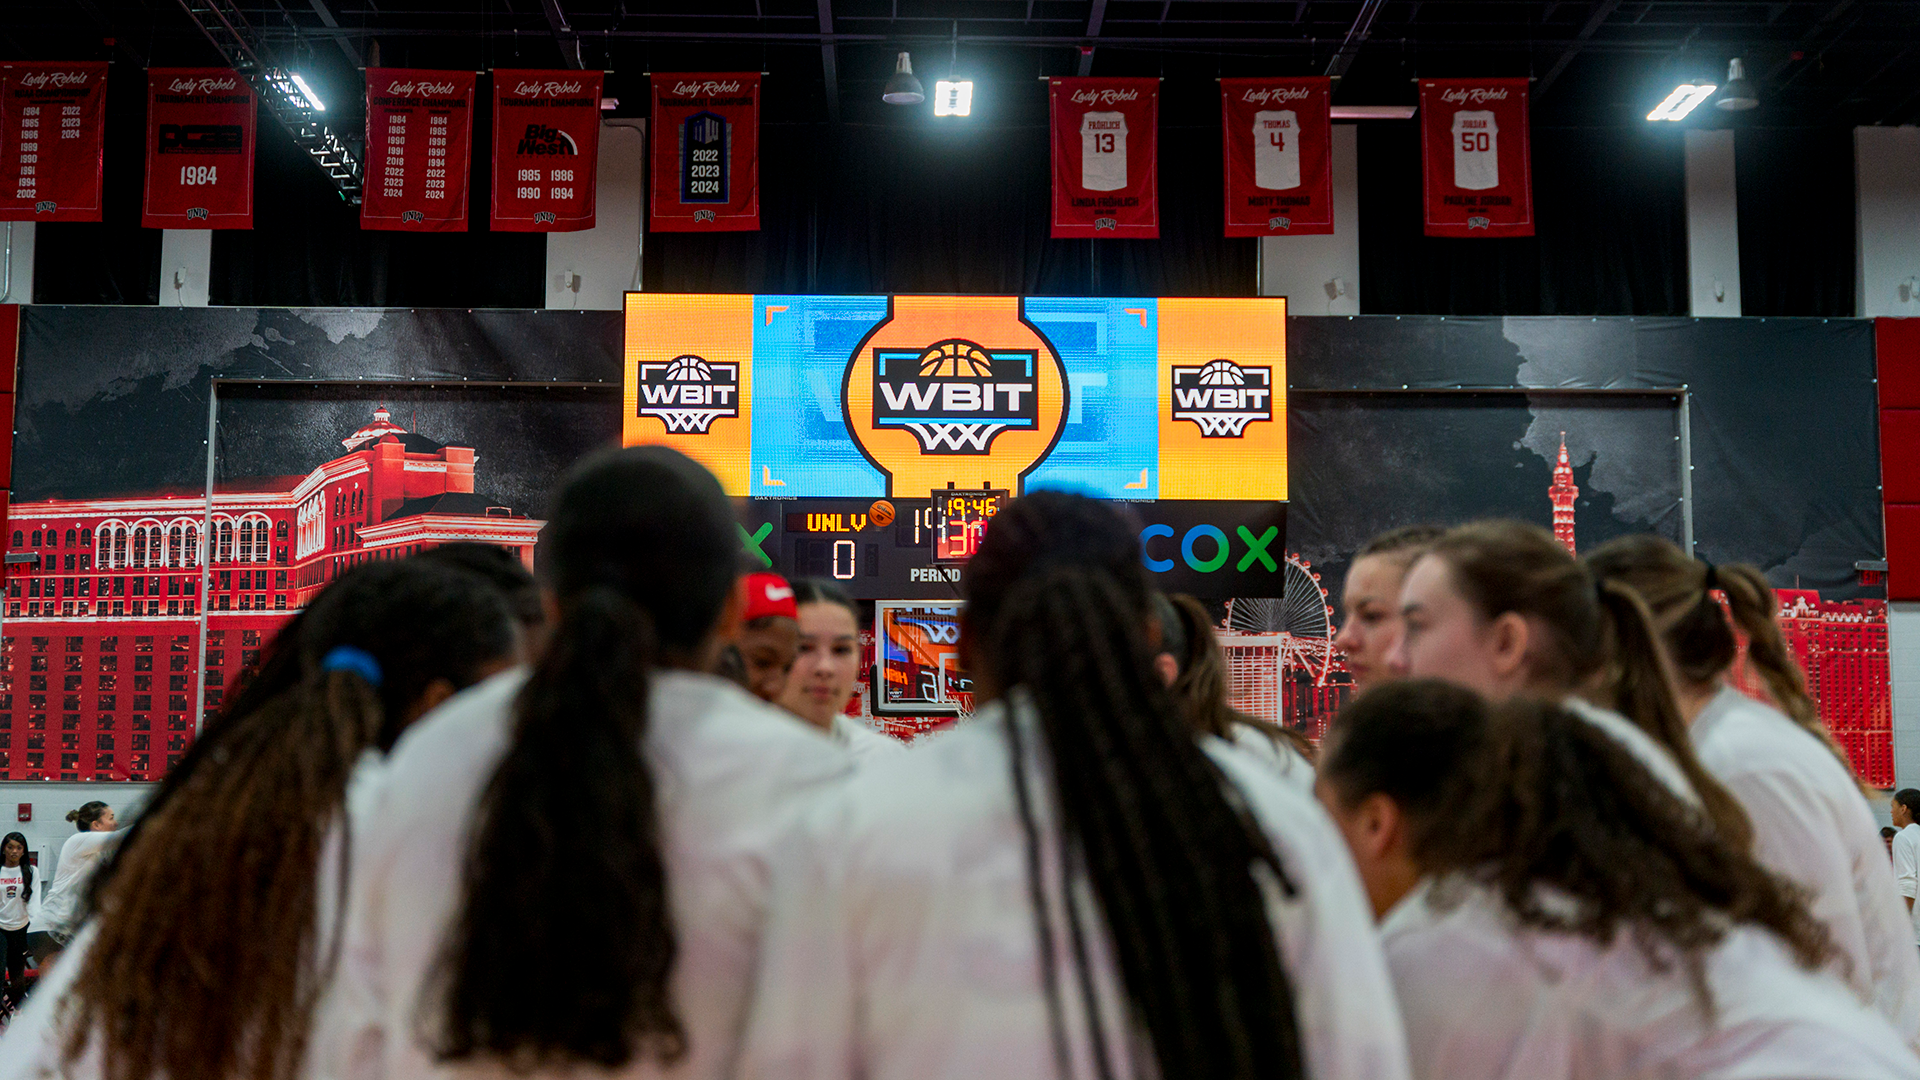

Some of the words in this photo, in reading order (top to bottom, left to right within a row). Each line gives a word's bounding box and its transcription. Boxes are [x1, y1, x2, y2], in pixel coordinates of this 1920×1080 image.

[21, 71, 49, 89] Lady
[50, 72, 87, 87] Rebels
[169, 78, 197, 95] Lady
[199, 78, 236, 94] Rebels
[386, 81, 416, 97] Lady
[417, 82, 455, 97] Rebels
[514, 81, 542, 98] Lady
[544, 81, 581, 96] Rebels
[672, 81, 701, 98] Lady
[702, 81, 740, 96] Rebels
[1071, 89, 1099, 106] Lady
[1101, 89, 1138, 104] Rebels
[1242, 88, 1270, 105] Lady
[1272, 87, 1309, 103] Rebels
[1441, 88, 1470, 105] Lady
[1470, 88, 1508, 104] Rebels
[373, 97, 420, 107] CONFERENCE
[422, 99, 466, 108] CHAMPIONS
[500, 98, 549, 107] TOURNAMENT
[551, 98, 594, 107] CHAMPIONS
[23, 107, 40, 116] 1984
[62, 107, 80, 115] 2022
[22, 119, 39, 127] 1985
[61, 118, 80, 127] 2023
[389, 115, 406, 124] 1984
[430, 116, 447, 125] 1984
[1263, 120, 1290, 128] THOMAS
[21, 130, 38, 139] 1986
[61, 130, 80, 139] 2024
[388, 126, 405, 134] 1985
[430, 127, 447, 135] 1985
[525, 124, 558, 143] Big
[388, 136, 405, 145] 1990
[1095, 133, 1114, 153] 13
[1270, 132, 1285, 152] 4
[1462, 132, 1489, 152] 50
[21, 143, 38, 151] 1989
[388, 147, 403, 155] 1991
[516, 139, 571, 155] West
[428, 148, 446, 157] 1990
[693, 150, 718, 161] 2022
[20, 155, 37, 163] 1990
[386, 157, 404, 165] 2018
[428, 158, 445, 167] 1994
[21, 166, 35, 175] 1991
[180, 166, 217, 185] 1984
[385, 167, 404, 176] 2022
[427, 169, 445, 178] 2022
[518, 169, 540, 181] 1985
[551, 170, 573, 181] 1986
[691, 165, 719, 177] 2023
[19, 178, 35, 186] 1994
[384, 178, 403, 186] 2023
[426, 180, 445, 188] 2023
[691, 181, 719, 193] 2024
[16, 189, 36, 198] 2002
[384, 188, 403, 197] 2024
[425, 190, 444, 199] 2024
[517, 187, 540, 199] 1990
[551, 188, 573, 199] 1994
[641, 385, 735, 405] WBIT
[879, 382, 1032, 412] WBIT
[1175, 389, 1269, 409] WBIT
[948, 498, 997, 516] 19:46
[807, 513, 867, 532] UNLV
[1138, 524, 1278, 573] COX
[833, 539, 856, 579] 0
[911, 568, 961, 582] PERIOD
